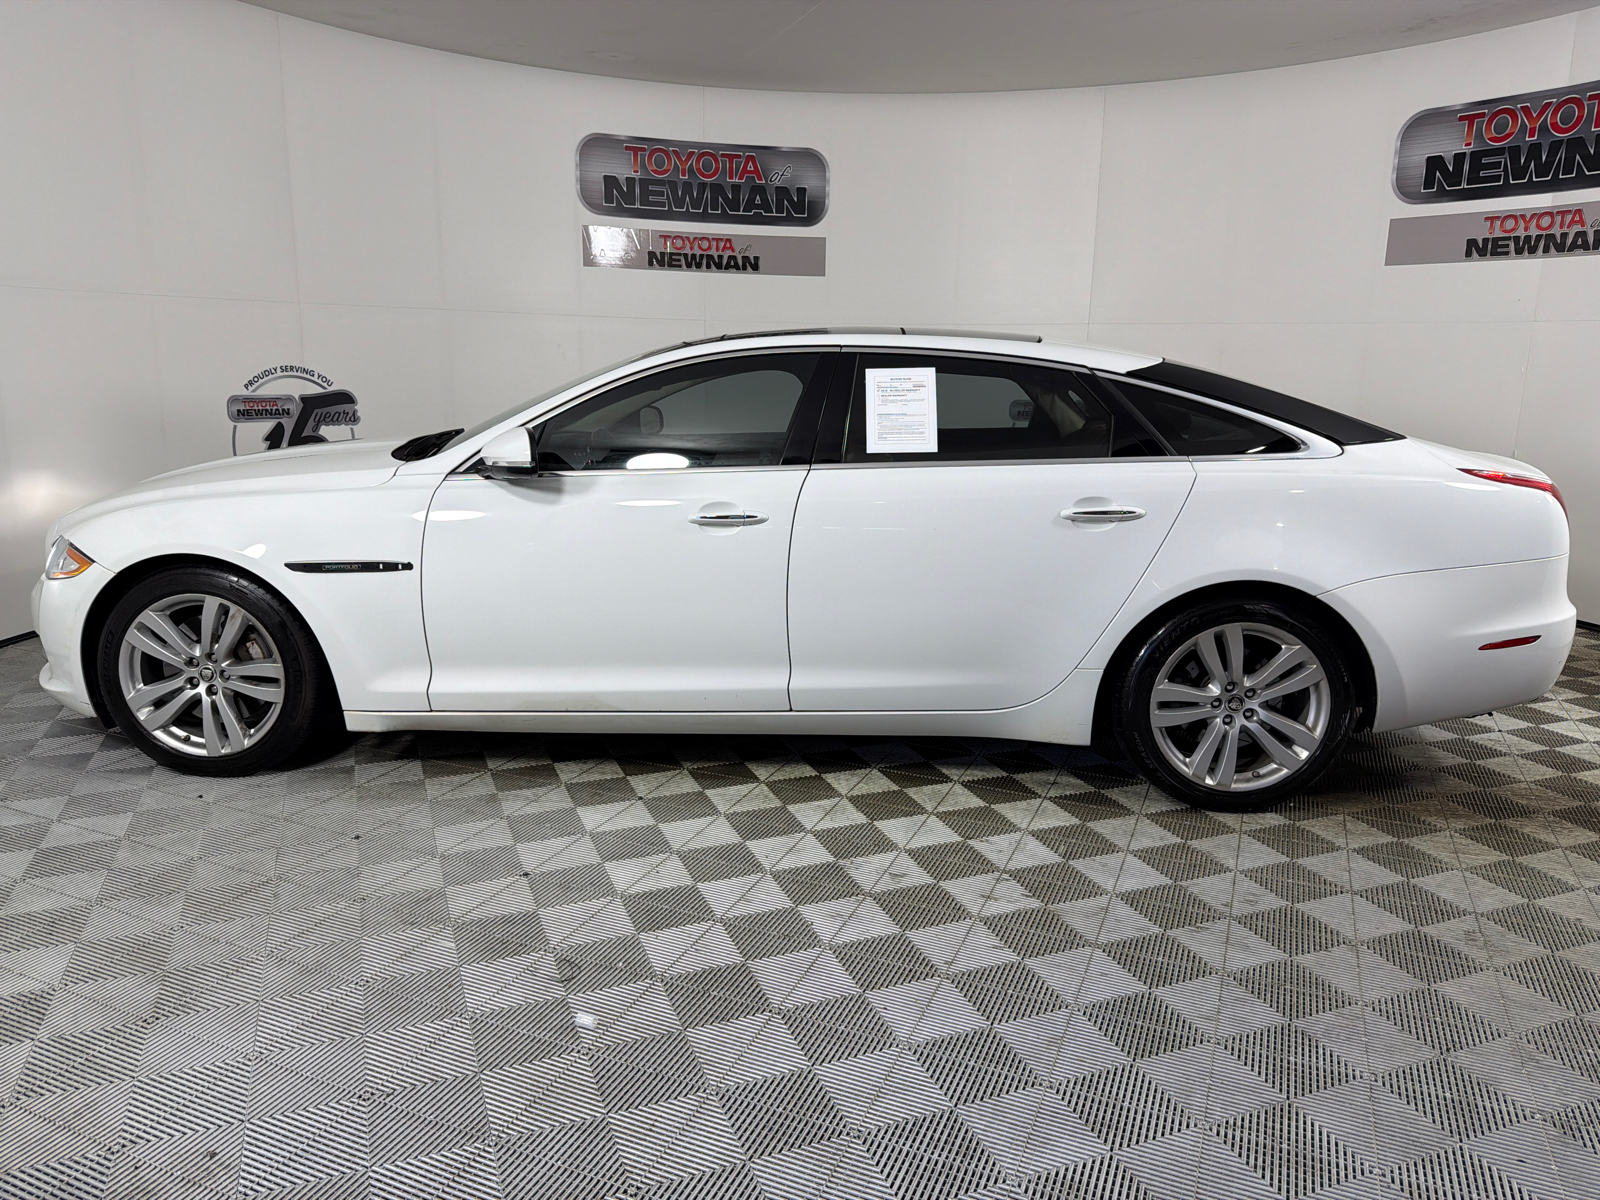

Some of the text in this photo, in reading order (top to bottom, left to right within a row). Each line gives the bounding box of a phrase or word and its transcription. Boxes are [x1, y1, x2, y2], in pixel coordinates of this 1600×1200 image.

[624, 144, 792, 184] TOYOTA of
[602, 174, 808, 218] NEWNAN
[1484, 208, 1586, 236] TOYOTA
[659, 234, 736, 254] TOYOTA
[647, 250, 760, 272] NEWNAN
[243, 365, 334, 391] PROUDLY SERVING YOU
[236, 407, 291, 418] NEWNAN
[242, 400, 279, 409] TOYOTA
[312, 409, 359, 434] years
